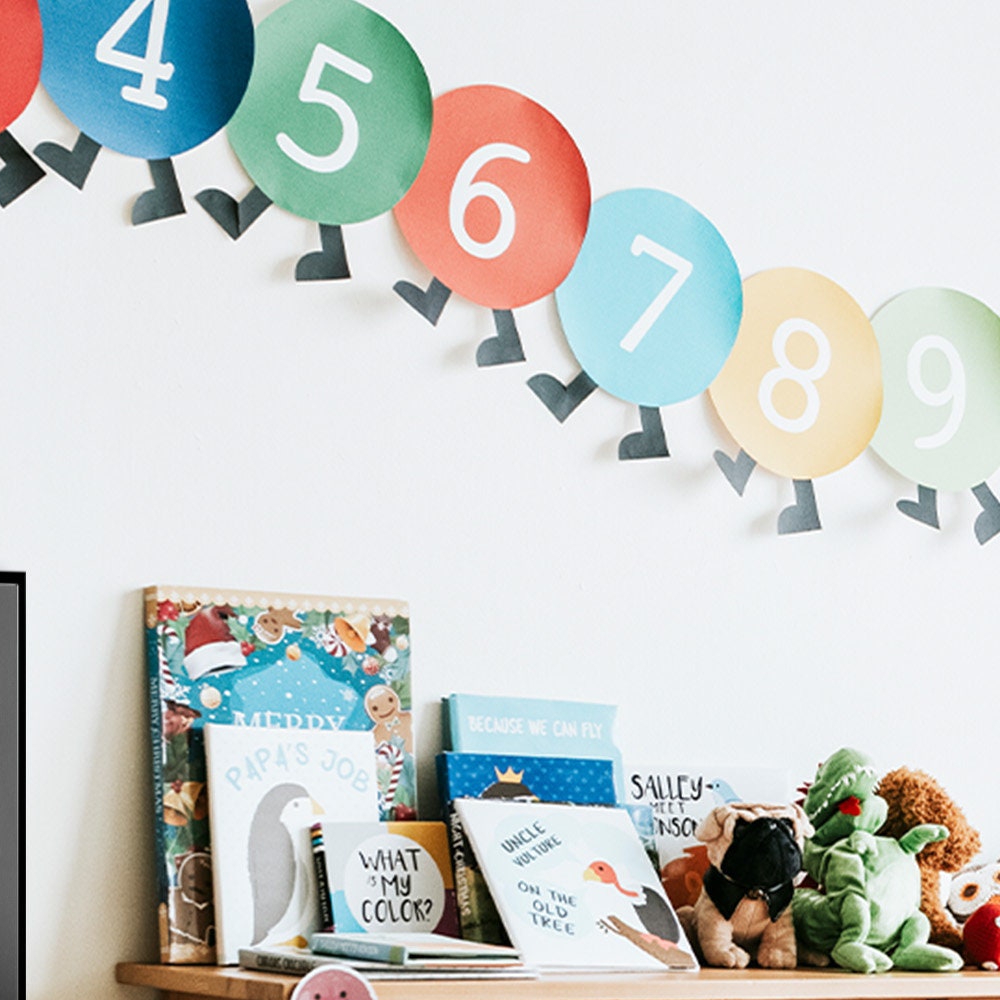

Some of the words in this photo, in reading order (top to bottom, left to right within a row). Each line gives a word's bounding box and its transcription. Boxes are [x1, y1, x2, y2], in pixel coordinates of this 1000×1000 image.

[94, 0, 175, 111] 4
[275, 42, 374, 173] 5
[449, 142, 531, 260] 6
[619, 234, 694, 354] 7
[758, 317, 831, 433] 8
[906, 334, 967, 450] 9
[468, 715, 524, 735] BECAUSE
[528, 720, 547, 735] WE
[553, 721, 577, 737] CAN
[582, 722, 602, 739] FLY
[225, 743, 309, 791] PAPA'S
[321, 749, 369, 793] JOB
[631, 774, 703, 801] SALLEY
[501, 821, 546, 853] UNCLE
[512, 834, 562, 868] VULTURE
[359, 848, 423, 872] WHAT
[517, 881, 541, 895] ON
[549, 889, 577, 907] THE
[532, 899, 568, 918] OLD
[362, 899, 433, 924] COLOR?
[529, 912, 575, 935] TREE
